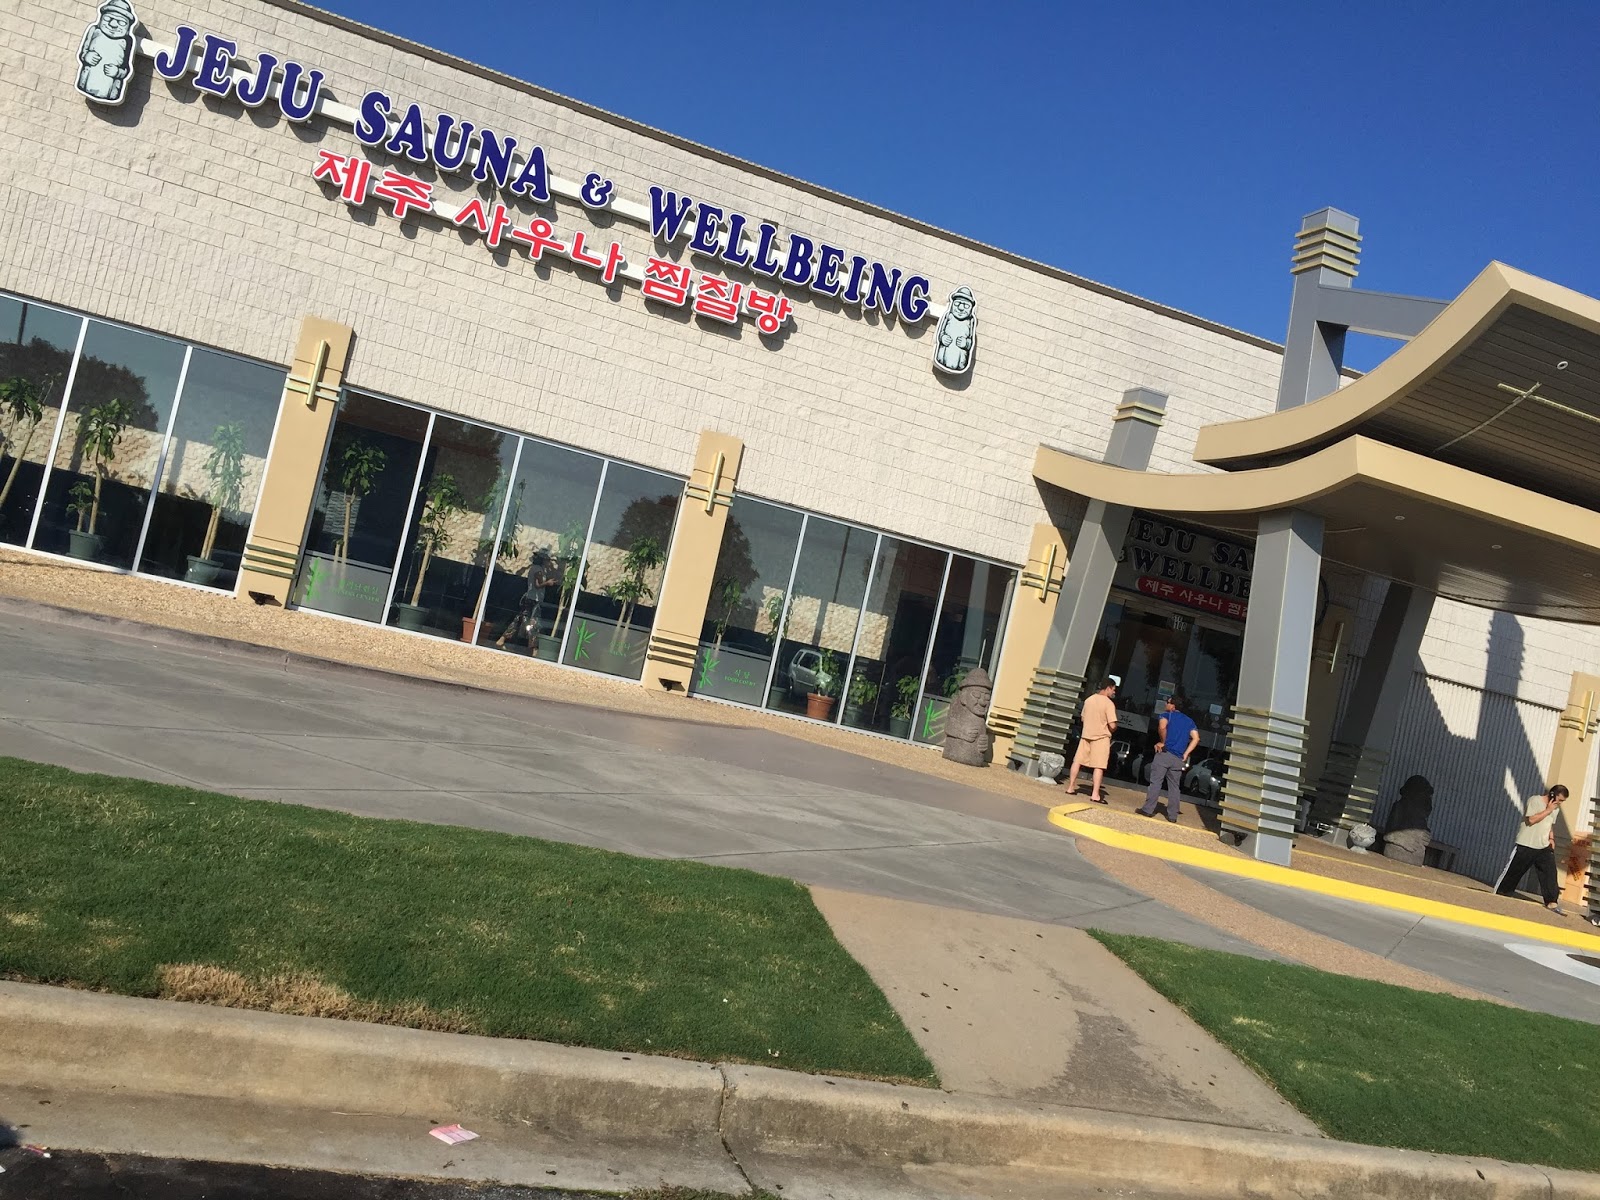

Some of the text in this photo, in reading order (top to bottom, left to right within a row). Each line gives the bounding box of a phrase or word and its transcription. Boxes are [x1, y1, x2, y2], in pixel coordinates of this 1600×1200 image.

[155, 25, 930, 323] JEJU SAUNA & WELLBEING
[313, 148, 793, 334] 제주 사우나 찜질방
[1132, 546, 1250, 598] WELLBE
[1212, 541, 1254, 573] SA
[1145, 579, 1174, 596] 제주
[1179, 588, 1224, 609] 사우나
